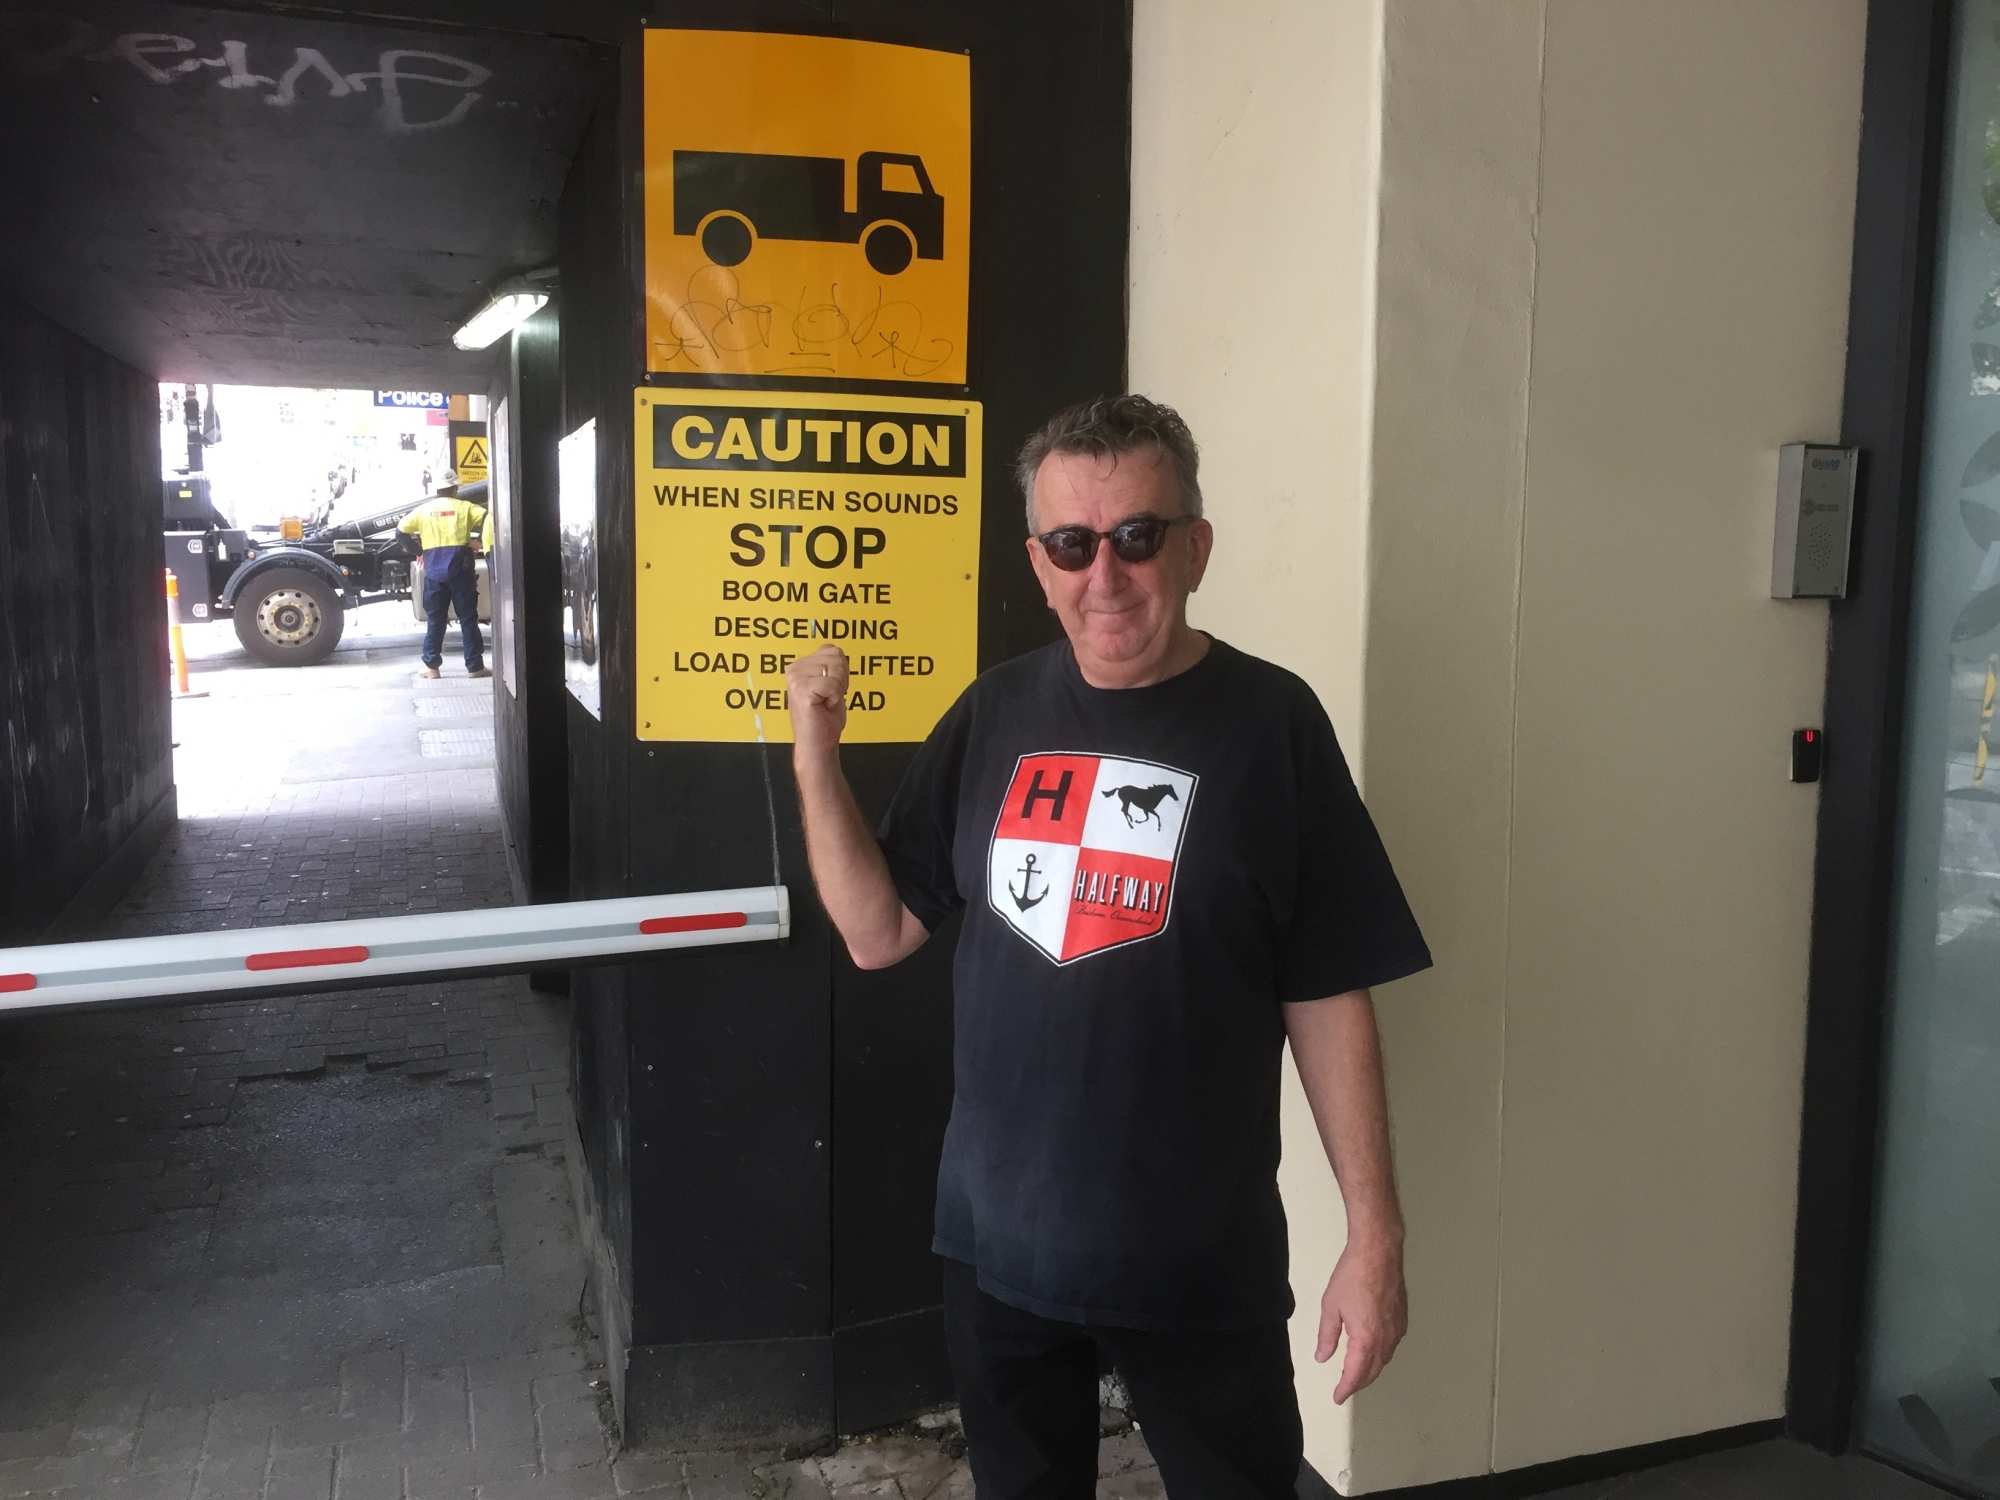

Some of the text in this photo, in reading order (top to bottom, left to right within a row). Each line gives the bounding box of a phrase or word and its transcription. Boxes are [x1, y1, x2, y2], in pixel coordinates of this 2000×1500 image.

[670, 415, 951, 467] CAUTION
[653, 485, 959, 515] WHEN SIREN SOUNDS
[729, 522, 887, 569] STOP
[722, 580, 892, 604] BOOM GATE
[714, 616, 899, 641] DESCENDING
[673, 651, 750, 673] LOAD
[724, 688, 886, 711] OVEAD
[1020, 769, 1074, 822] H
[1074, 869, 1165, 914] HALFWAY
